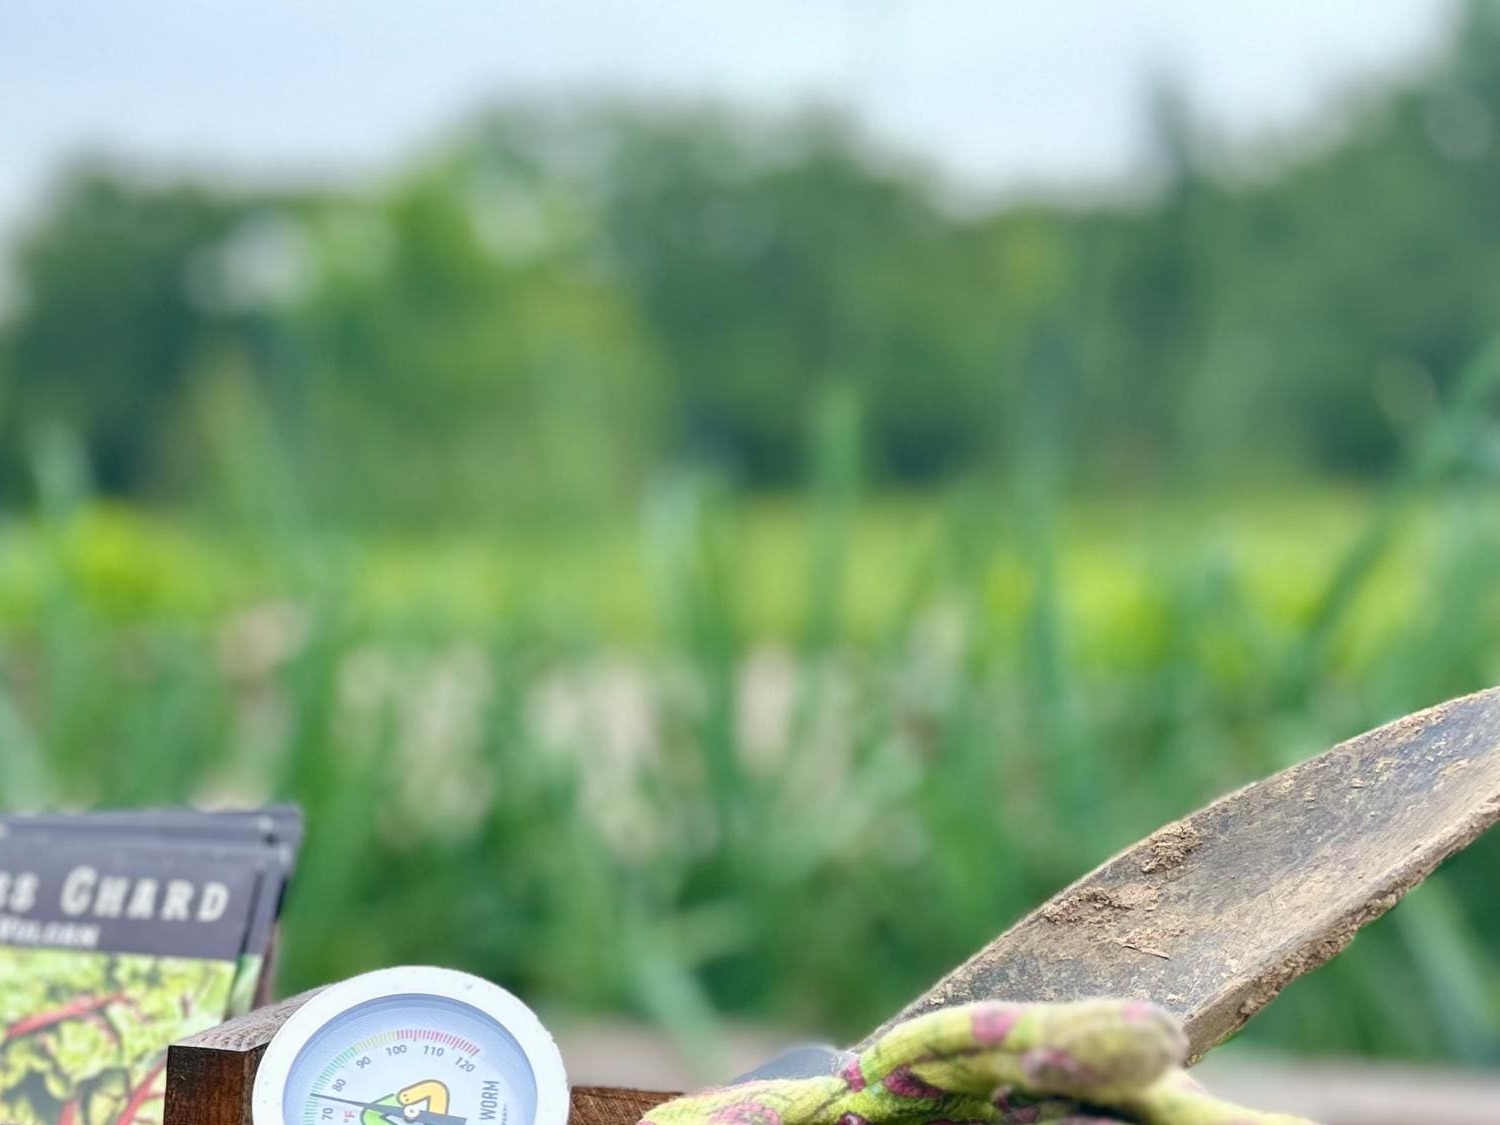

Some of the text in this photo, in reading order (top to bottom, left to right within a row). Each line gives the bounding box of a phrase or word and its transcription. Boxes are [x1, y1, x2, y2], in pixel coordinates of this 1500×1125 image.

[386, 1044, 407, 1056] 100
[423, 1045, 444, 1057] 110
[356, 1056, 371, 1068] 90
[455, 1057, 475, 1072] 120
[332, 1079, 346, 1091] 80
[479, 1080, 500, 1120] WORM
[321, 1107, 333, 1120] 70
